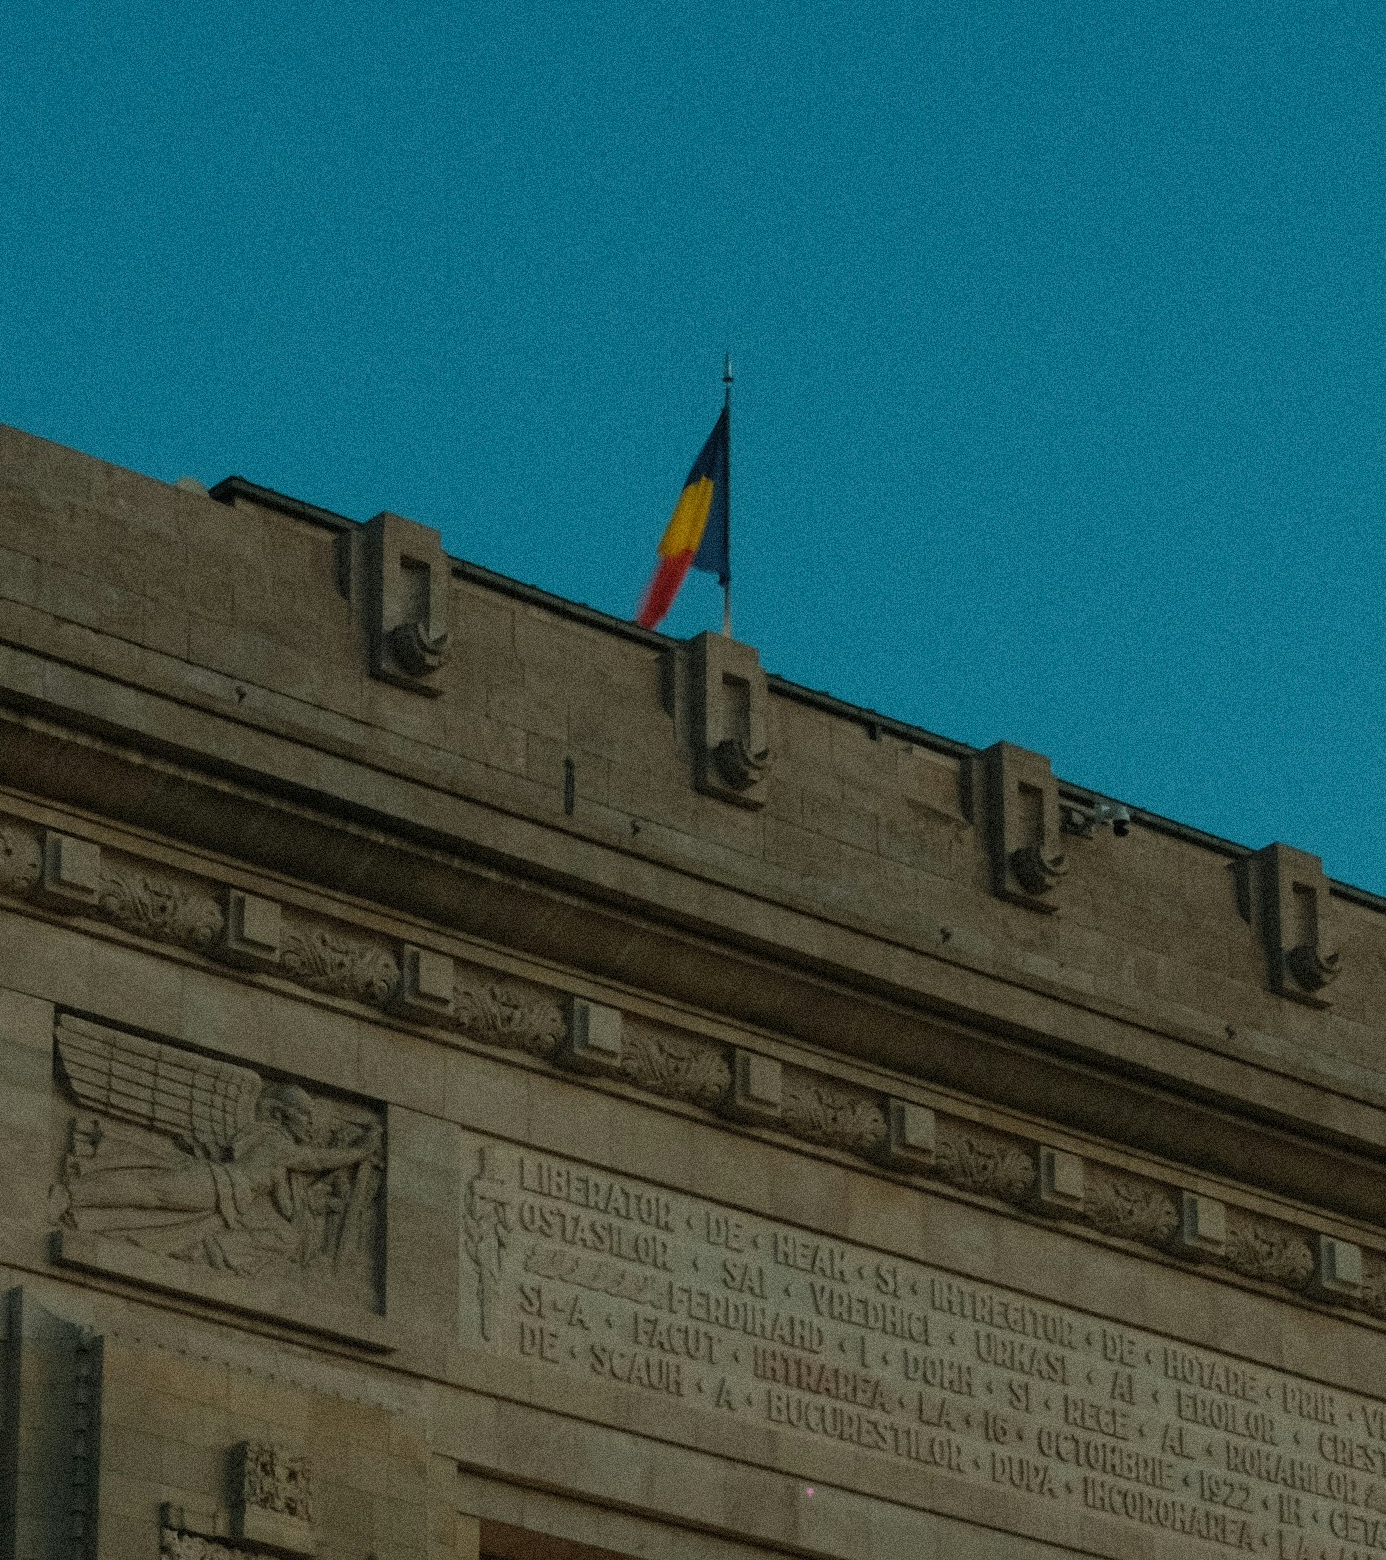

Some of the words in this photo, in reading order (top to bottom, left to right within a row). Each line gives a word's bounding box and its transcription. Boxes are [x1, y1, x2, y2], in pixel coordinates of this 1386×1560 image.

[519, 1156, 675, 1232] LIBERATOR
[706, 1211, 744, 1253] DE
[875, 1262, 900, 1298] SI
[930, 1277, 1077, 1350] INTREGITOR
[1101, 1329, 1137, 1368] DE
[1162, 1346, 1258, 1403] HOTARE
[1283, 1381, 1337, 1426] PRIN
[519, 1198, 673, 1272] OSTASILOR
[722, 1259, 768, 1299] SAI
[810, 1283, 931, 1346] VREDNICI
[975, 1330, 1069, 1385] URMASI
[1110, 1369, 1135, 1405] AI
[1176, 1390, 1278, 1445] EROILOR
[668, 1282, 824, 1354] FERDINAND
[860, 1336, 868, 1367] I
[1008, 1382, 1032, 1413] SI
[1064, 1394, 1129, 1442] REGE
[1160, 1424, 1195, 1460] AL
[1226, 1440, 1359, 1507] ROMANILOR
[519, 1322, 559, 1364] DE
[590, 1343, 685, 1397] SCAUN
[715, 1377, 737, 1412] A
[767, 1388, 965, 1473] BUCURESTILOR
[992, 1451, 1058, 1498] DUPA
[633, 1312, 721, 1364] FACUT
[753, 1345, 893, 1413] INTRAREA
[918, 1391, 956, 1432] LA
[984, 1410, 1009, 1445] 16
[1037, 1426, 1175, 1492] OCTOMBRIE
[1200, 1470, 1254, 1513] 1922
